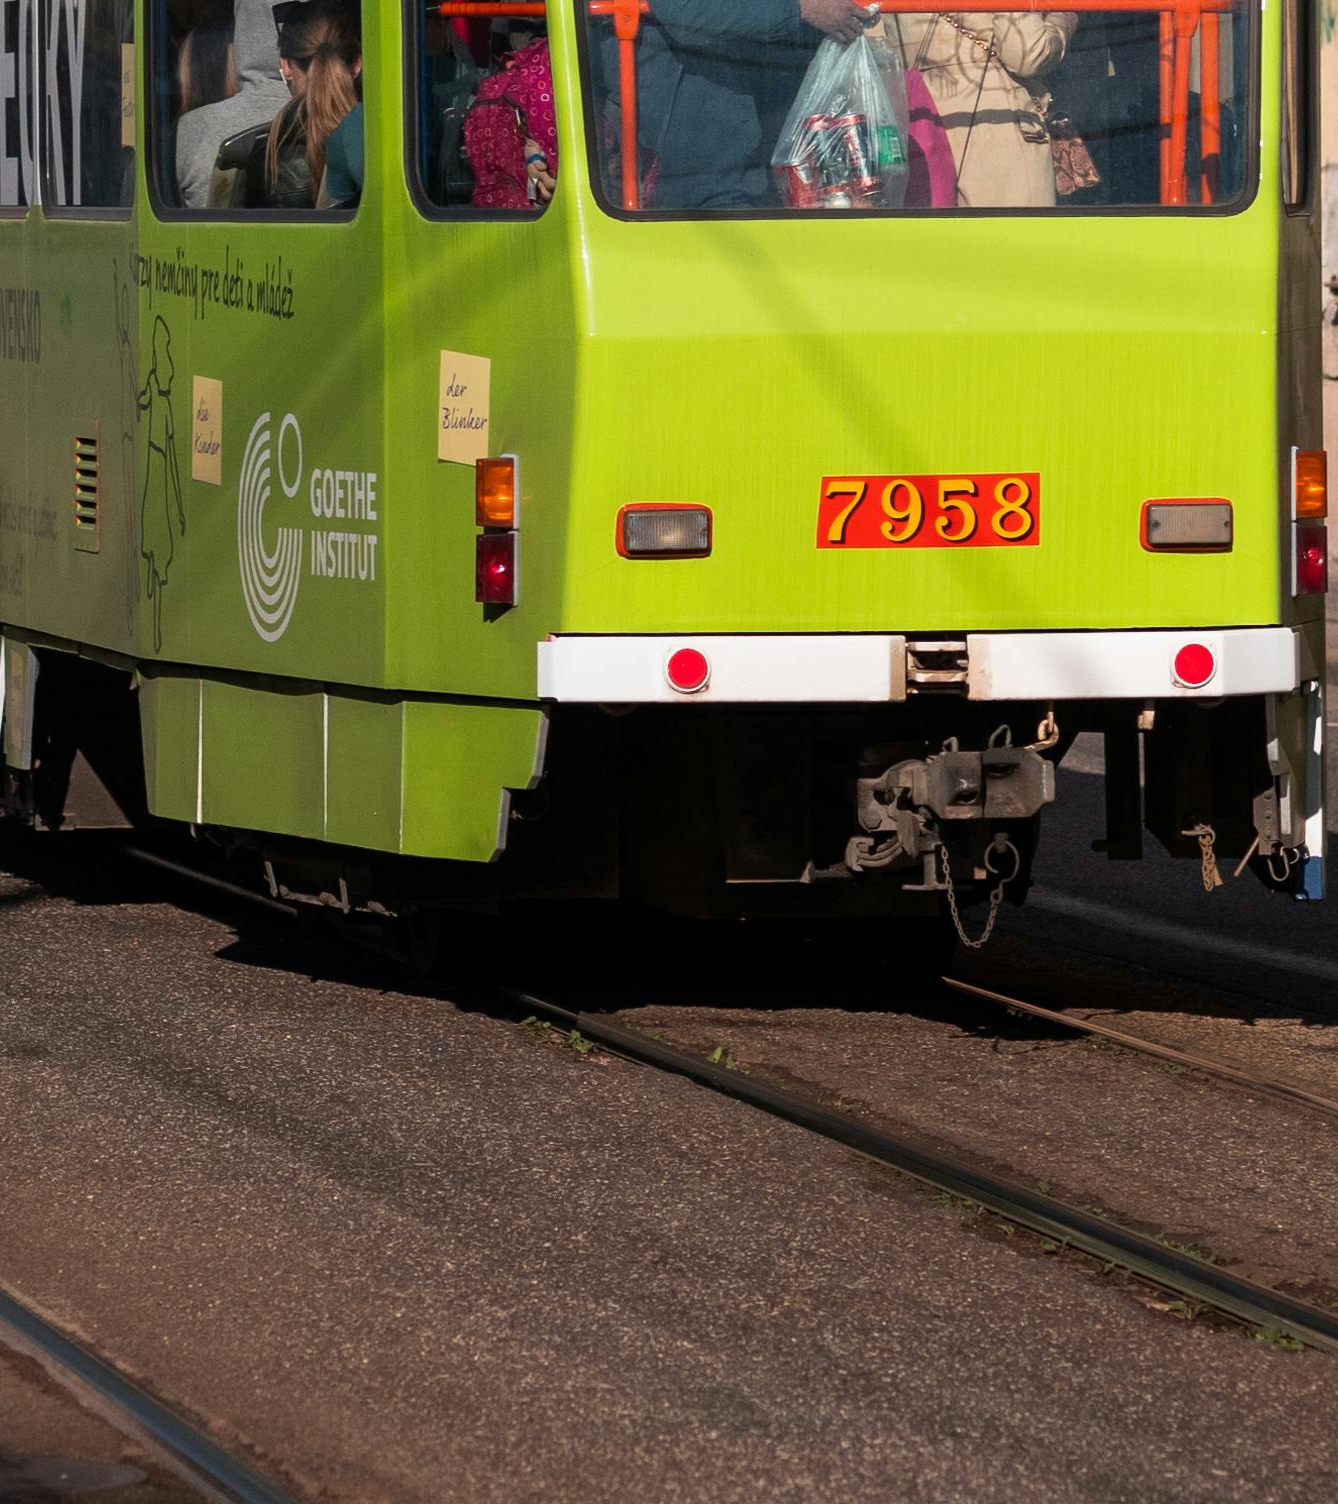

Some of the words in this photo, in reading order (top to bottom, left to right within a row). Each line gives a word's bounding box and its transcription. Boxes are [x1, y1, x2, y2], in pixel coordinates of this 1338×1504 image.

[155, 247, 198, 320] nemčiny
[201, 267, 220, 320] pre
[222, 244, 244, 308] deti
[246, 279, 254, 312] a
[256, 255, 295, 321] mládež
[446, 373, 467, 398] der
[442, 407, 488, 430] Blinker
[310, 467, 377, 521] GOETHE
[825, 477, 1034, 544] 7958
[311, 530, 377, 581] INSTITUT
